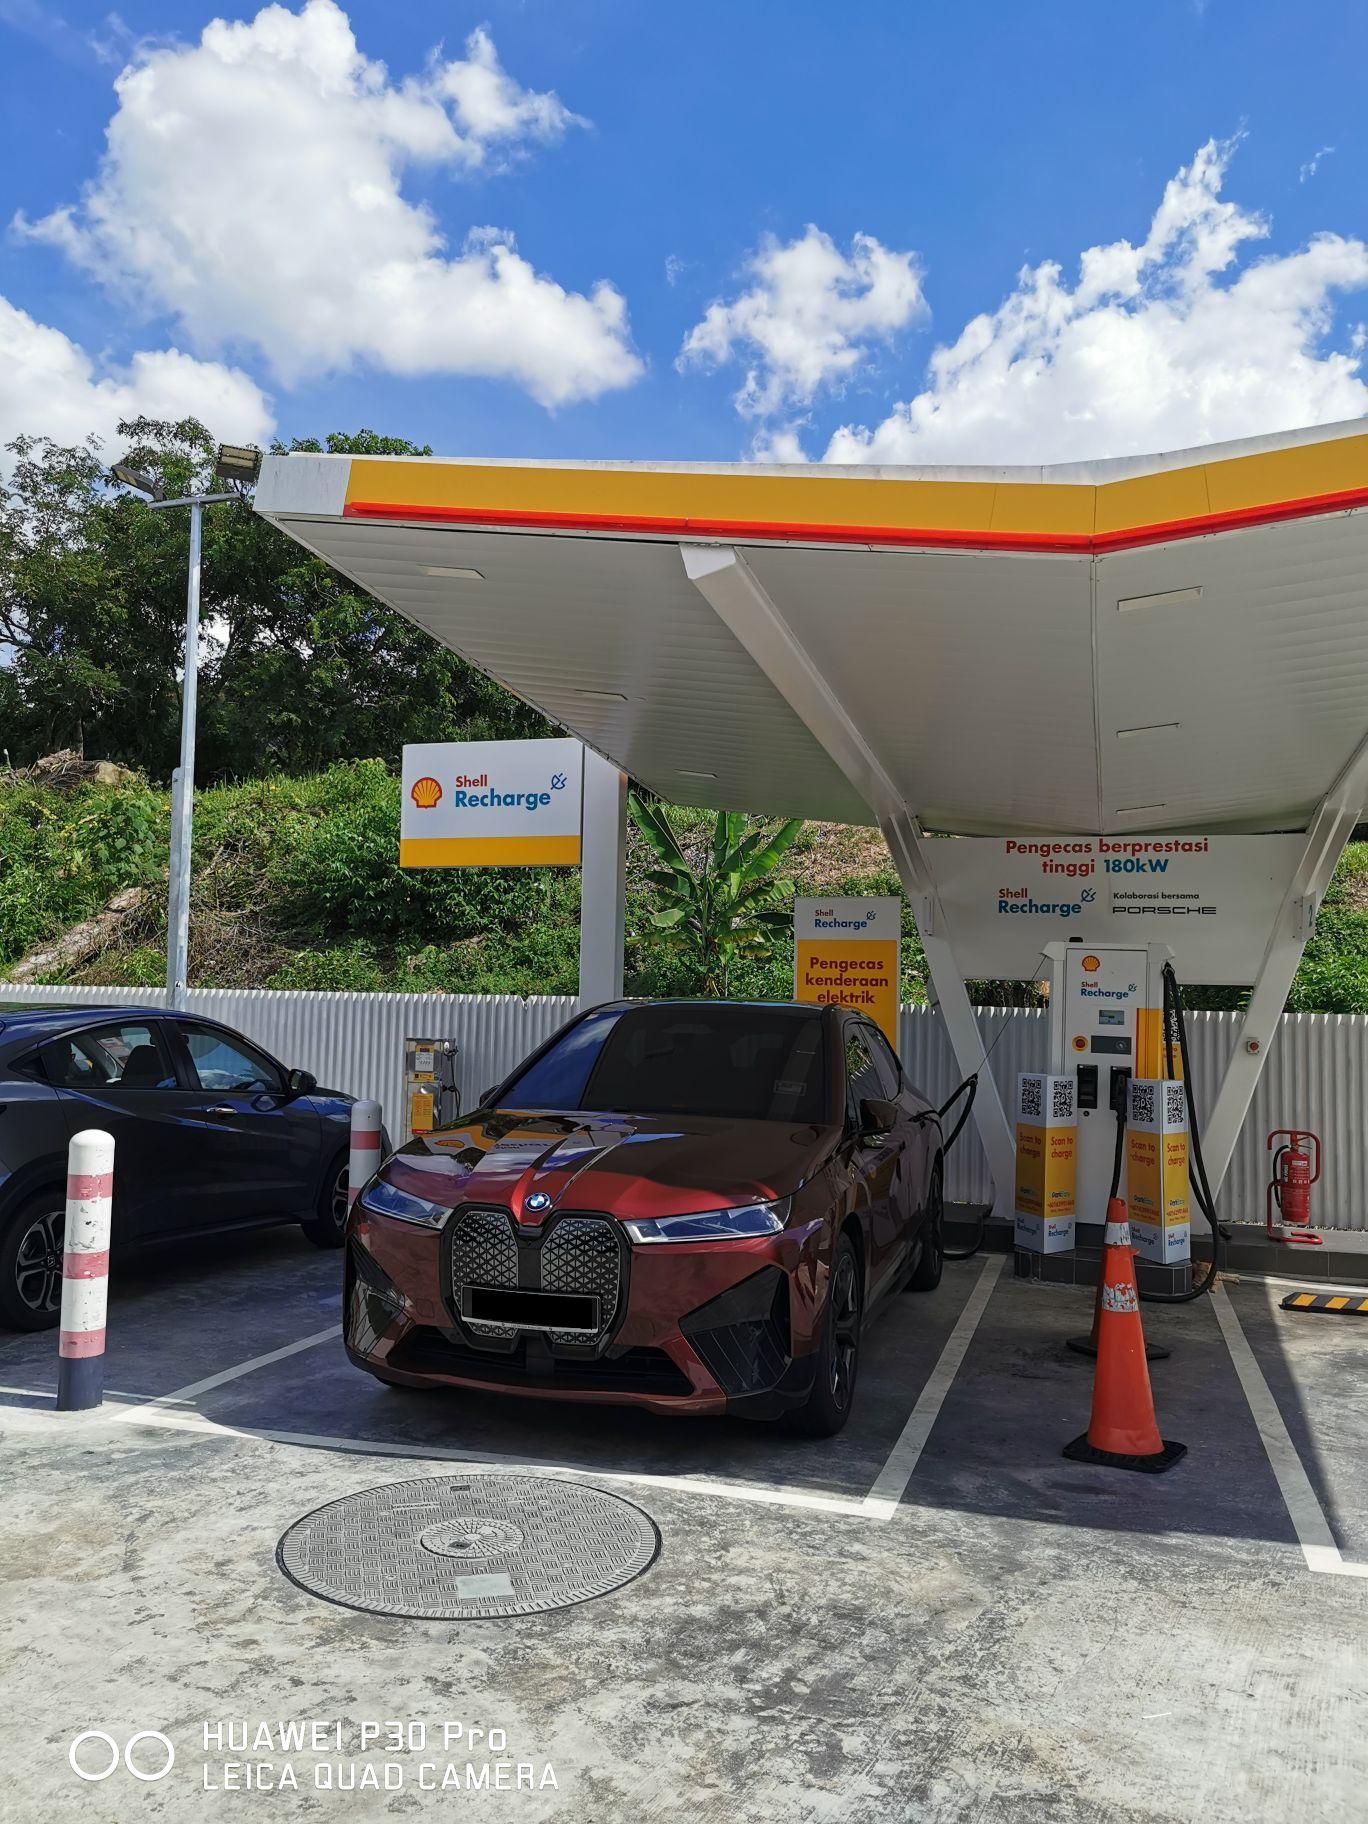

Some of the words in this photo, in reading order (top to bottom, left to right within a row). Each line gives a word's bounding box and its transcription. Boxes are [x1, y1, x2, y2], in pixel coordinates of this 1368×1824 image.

[455, 774, 488, 787] Shell
[455, 788, 551, 811] Recharge
[1005, 840, 1092, 857] Pengecas
[1099, 838, 1209, 857] berprestasi
[1042, 859, 1095, 877] tinggi
[1104, 858, 1169, 873] 180kW
[998, 888, 1028, 899] Shell
[1113, 892, 1159, 900] Kolaborasi
[1161, 892, 1200, 900] bersama
[815, 909, 834, 917] Shell
[998, 899, 1082, 917] Recharge
[1112, 906, 1217, 915] PORSCHE
[814, 918, 867, 930] Recharge
[810, 957, 884, 972] Pengecas
[805, 973, 888, 987] kenderaan
[817, 990, 875, 1004] elektrik
[1080, 988, 1129, 1000] Recharge
[1051, 1136, 1065, 1146] Scan
[1066, 1136, 1073, 1145] to
[1131, 1139, 1146, 1151] Scan
[1148, 1143, 1156, 1153] to
[1167, 1143, 1179, 1153] Scan
[1051, 1149, 1073, 1160] charge
